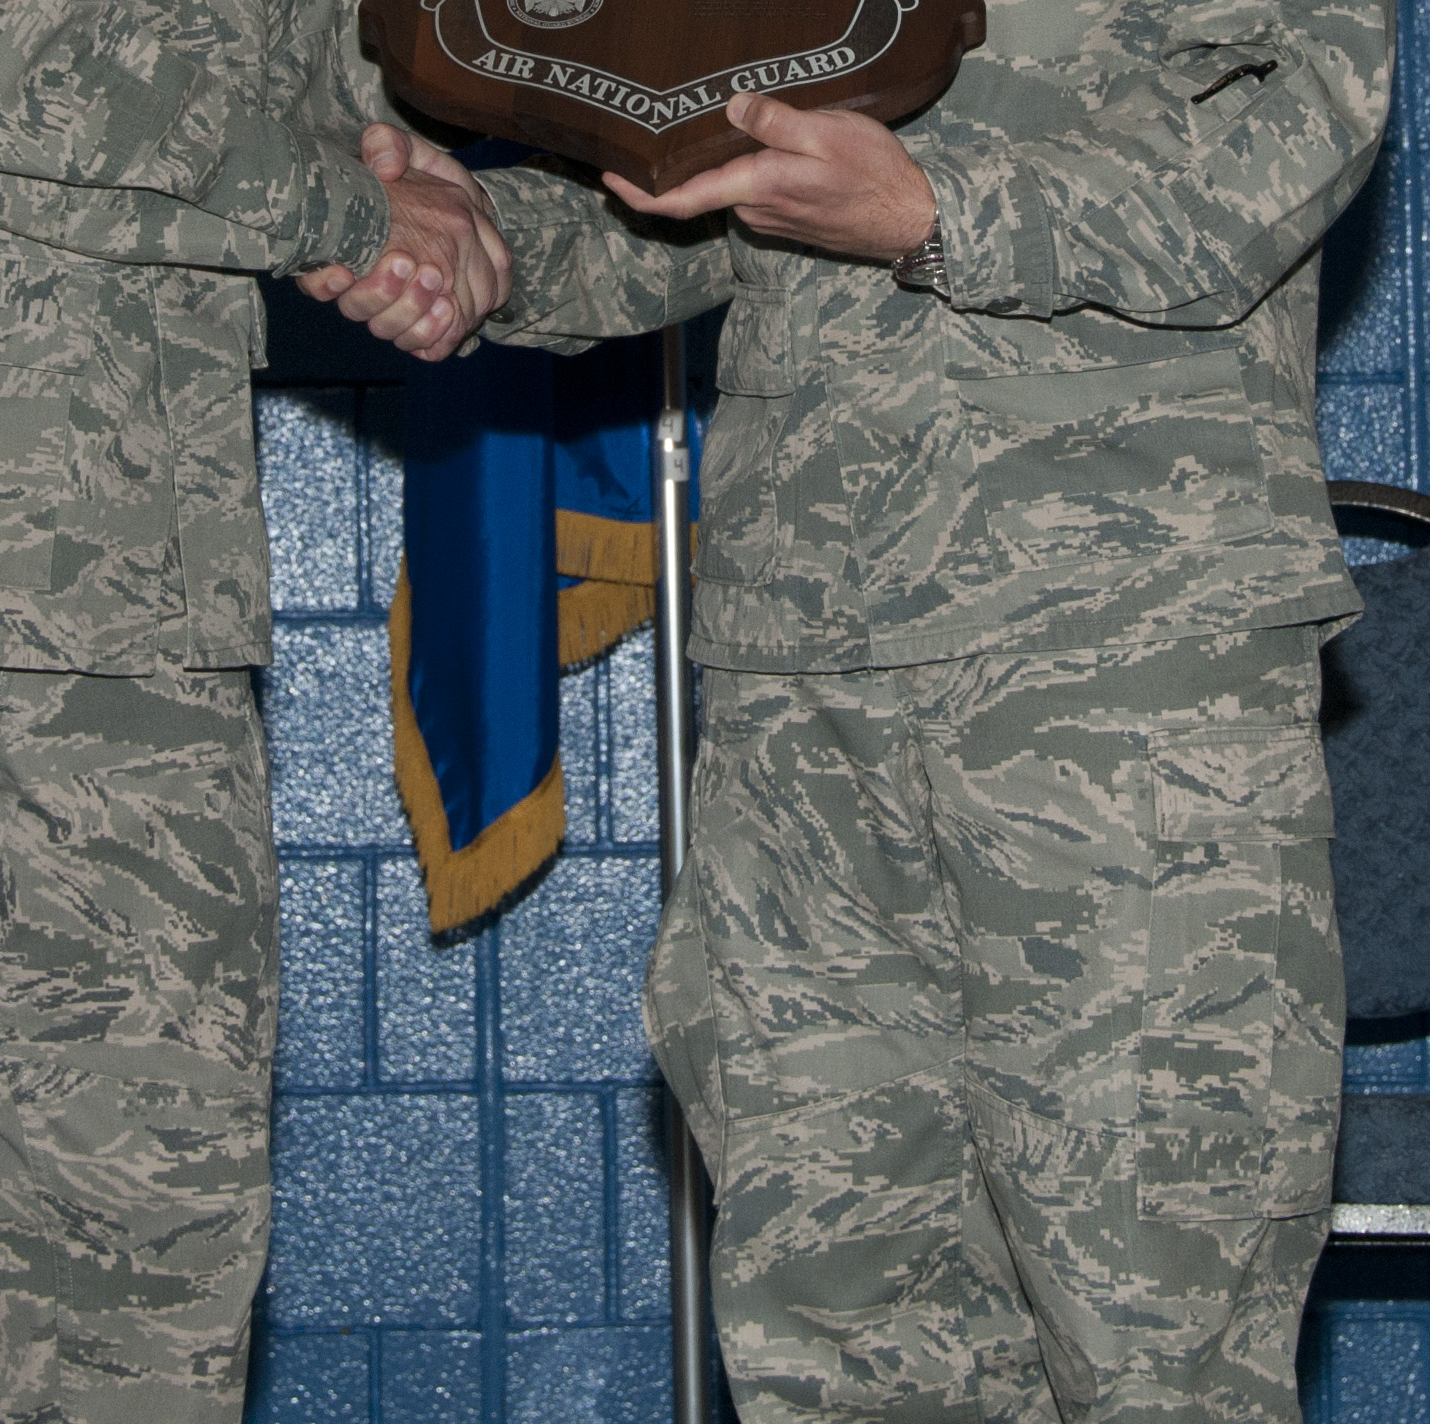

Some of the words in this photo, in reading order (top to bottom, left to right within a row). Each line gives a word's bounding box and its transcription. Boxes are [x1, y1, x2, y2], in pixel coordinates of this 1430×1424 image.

[472, 48, 535, 80] AIR
[543, 62, 722, 126] NATIONAL
[730, 45, 857, 95] GUARD
